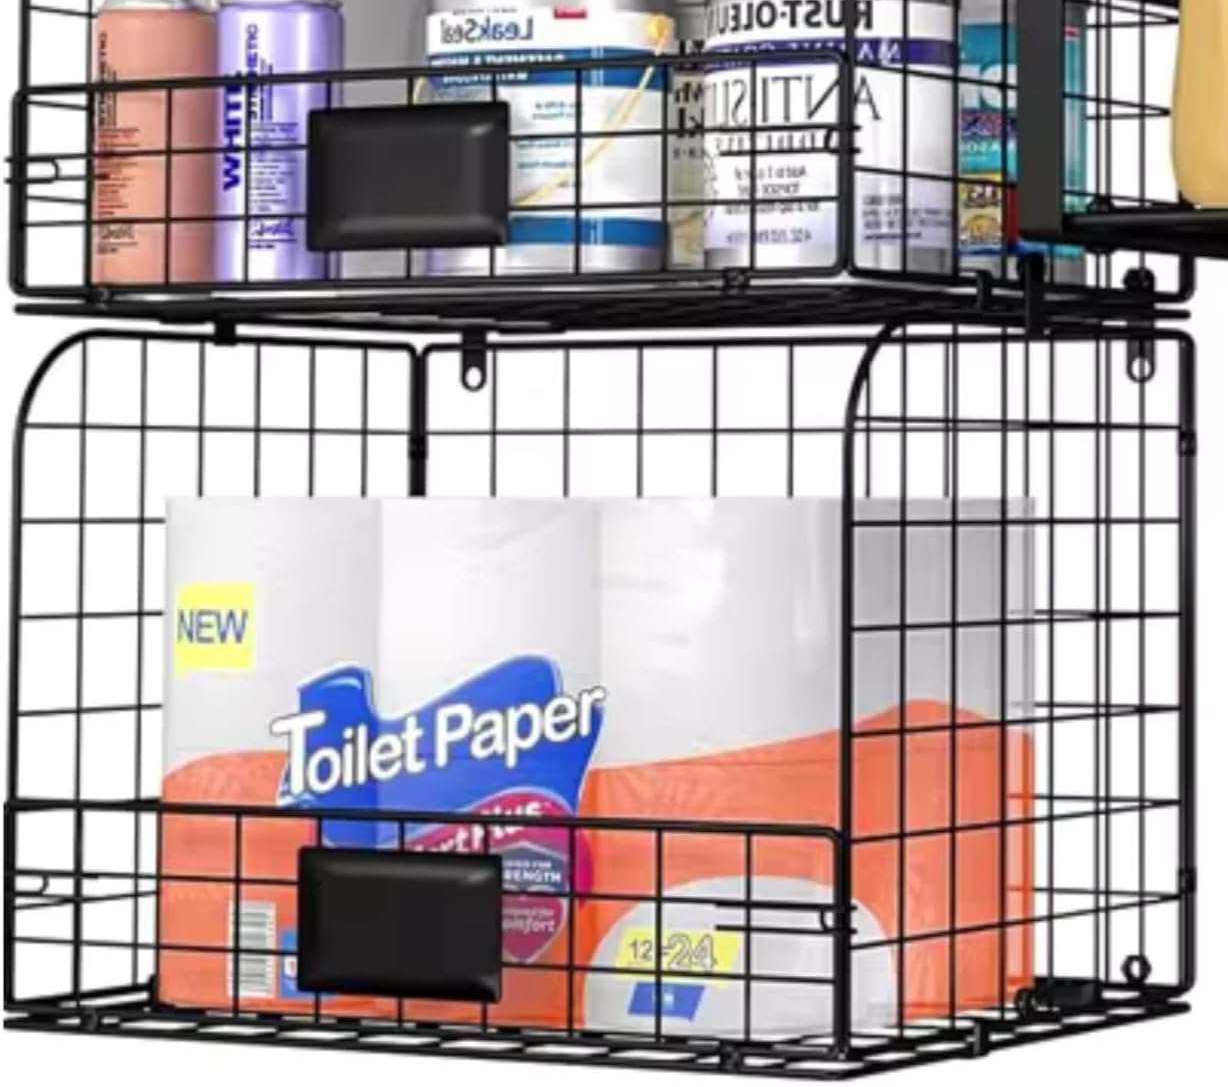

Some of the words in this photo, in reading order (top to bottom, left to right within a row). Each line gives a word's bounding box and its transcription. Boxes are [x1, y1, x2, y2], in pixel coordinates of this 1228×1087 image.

[177, 608, 249, 645] NEW
[269, 710, 426, 795] Toilet
[435, 685, 608, 771] Paper
